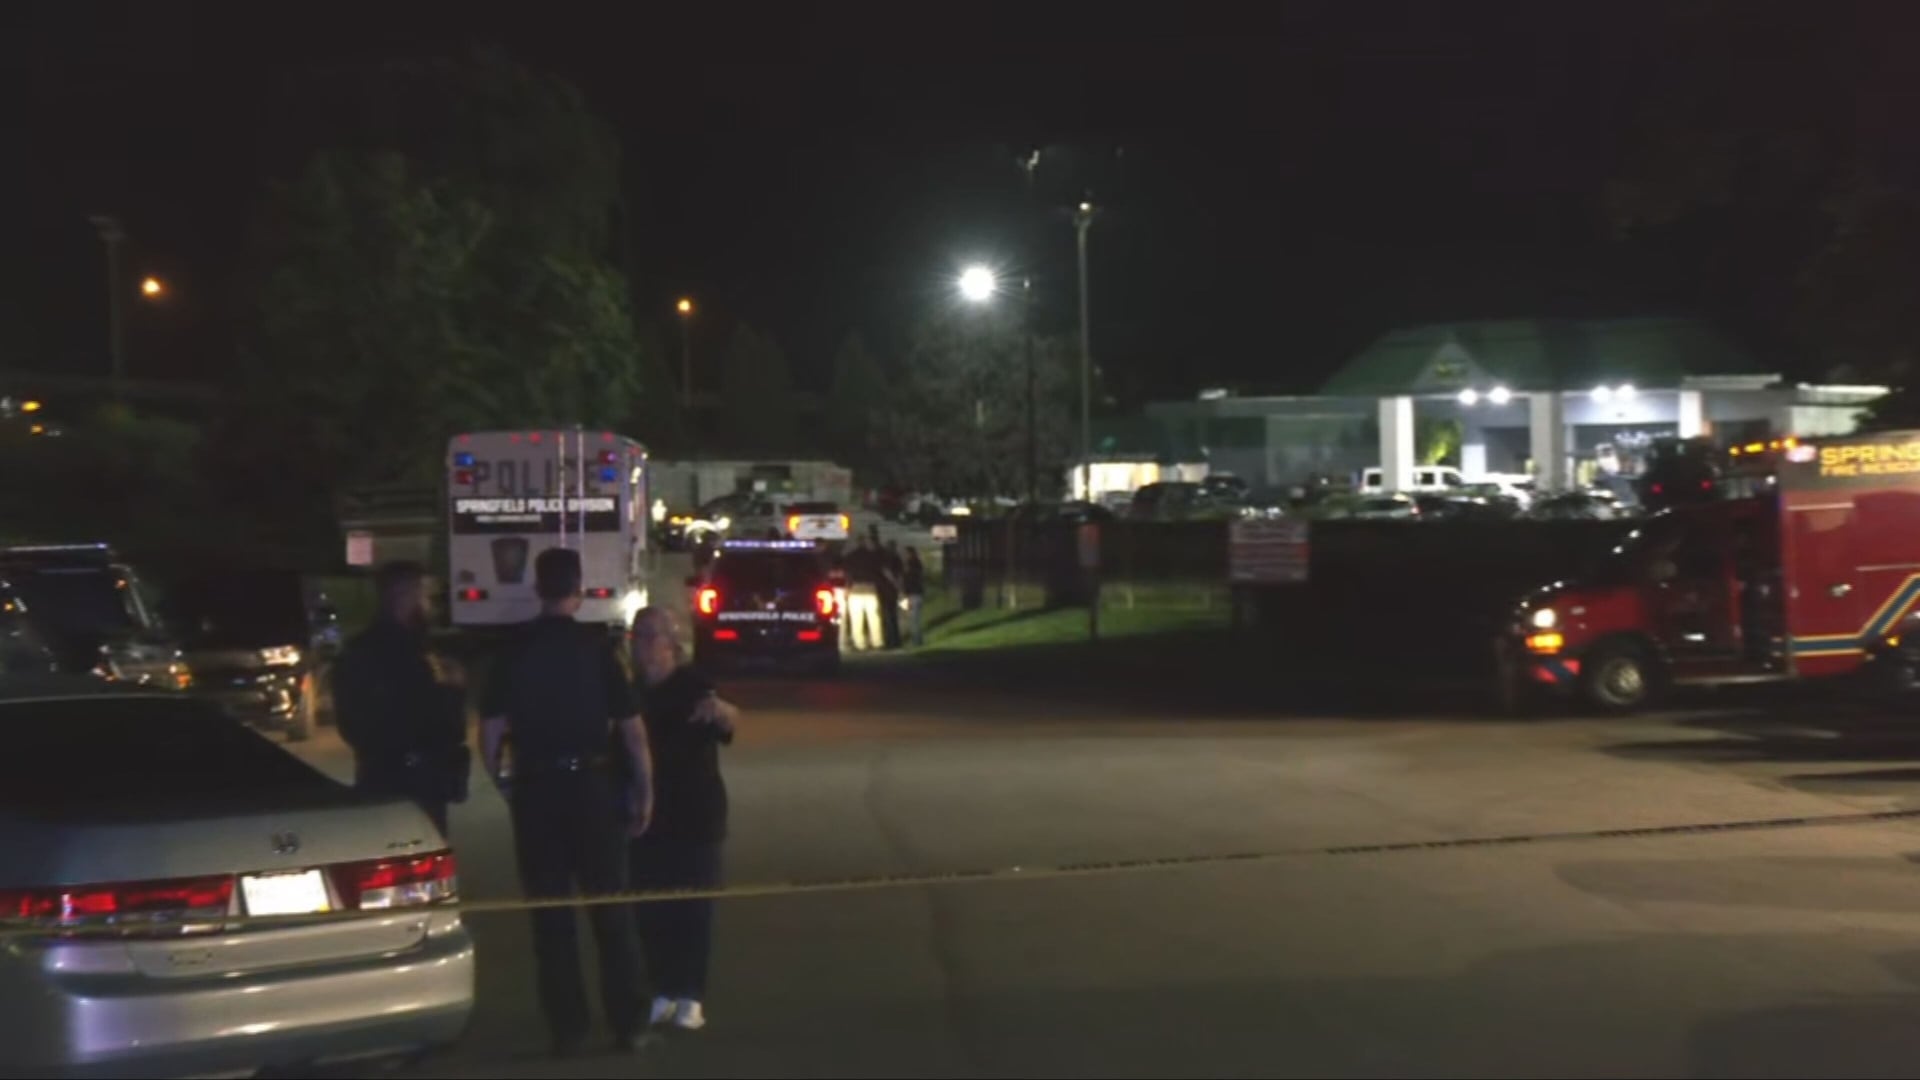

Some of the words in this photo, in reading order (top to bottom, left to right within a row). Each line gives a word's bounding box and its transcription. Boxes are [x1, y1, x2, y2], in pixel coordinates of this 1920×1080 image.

[1821, 442, 1920, 465] SPRING
[473, 459, 603, 495] POLICE
[456, 498, 526, 514] SPRINGFIELD
[527, 498, 564, 513] POLICE
[717, 611, 780, 622] SPRINGFIELD
[781, 611, 816, 622] POLICE
